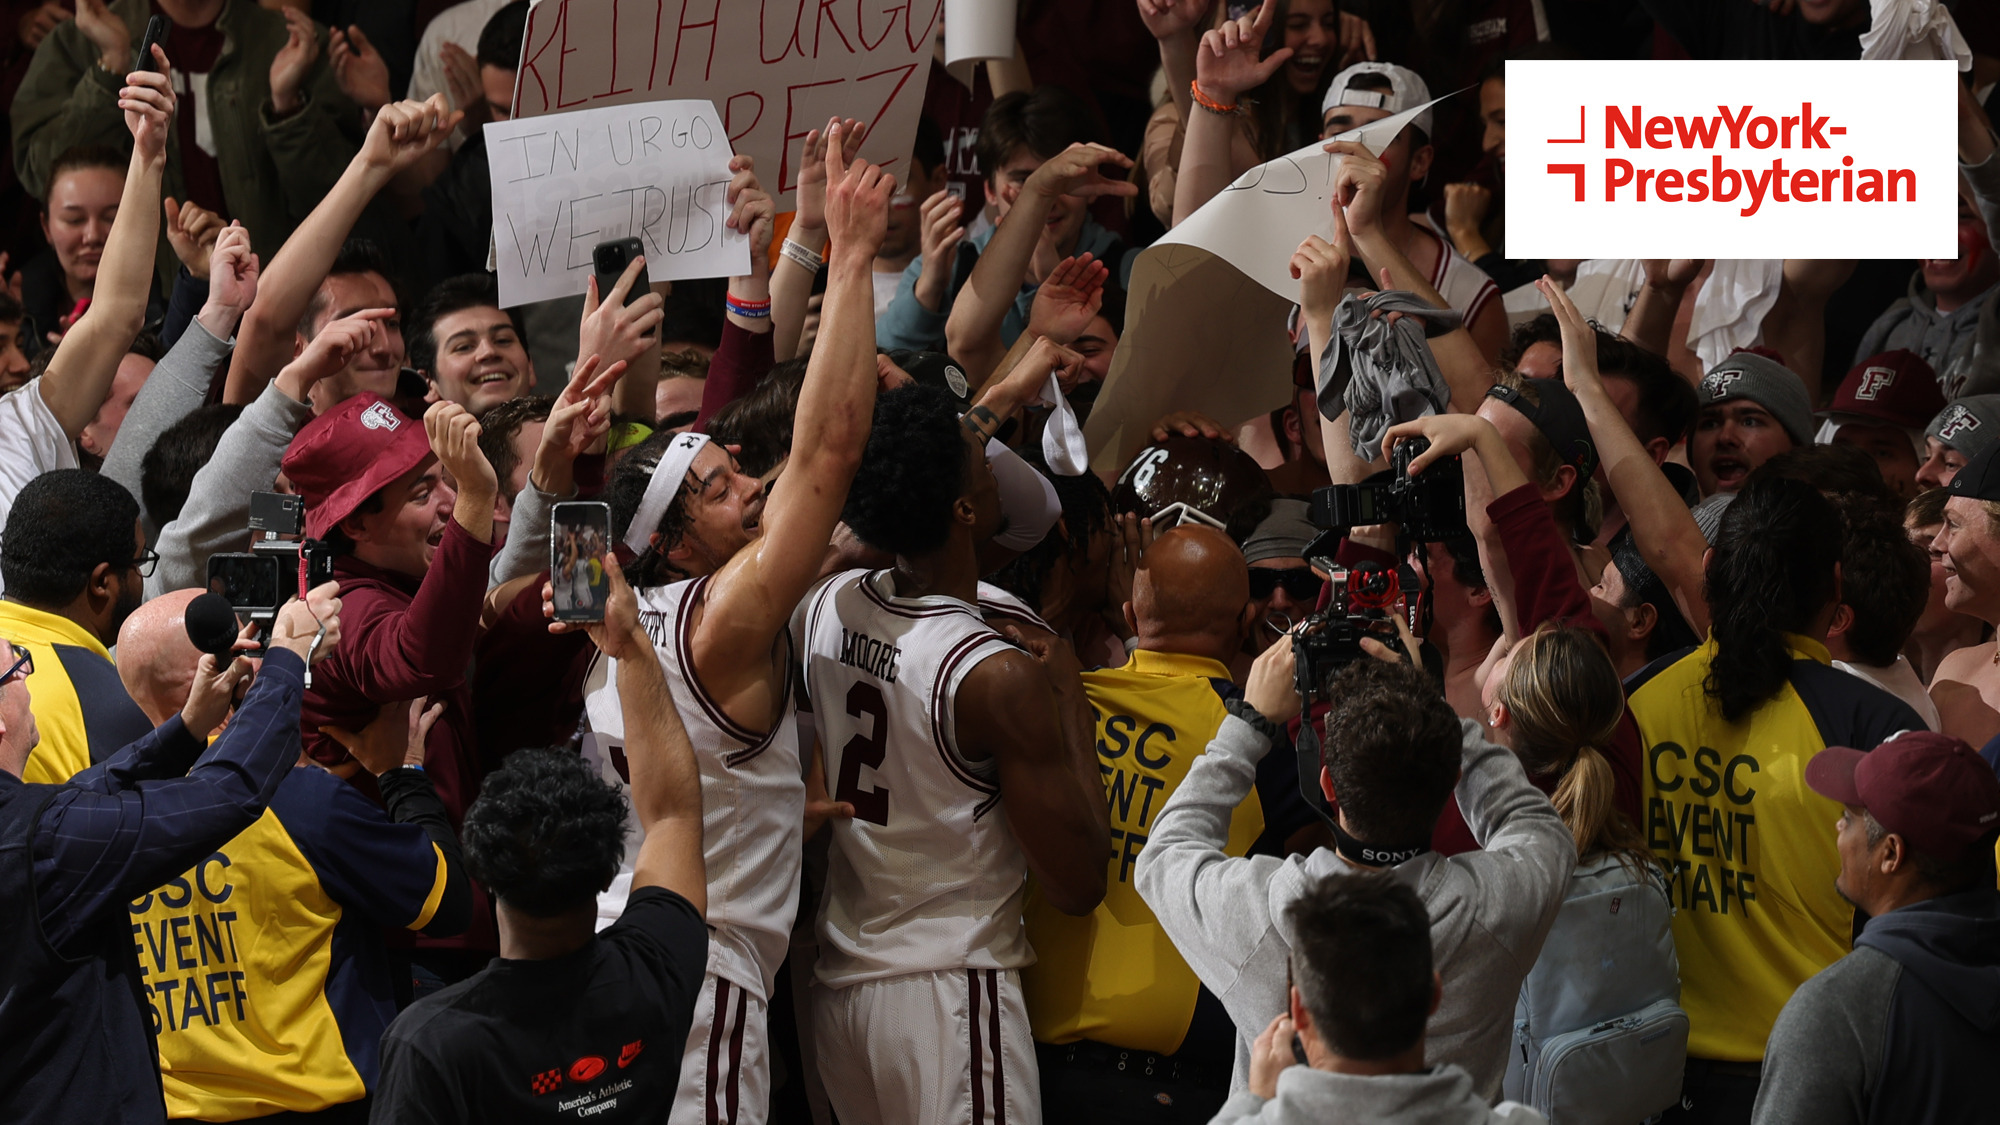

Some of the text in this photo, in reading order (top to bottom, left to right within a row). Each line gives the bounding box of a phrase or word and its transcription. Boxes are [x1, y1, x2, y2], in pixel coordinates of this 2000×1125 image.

[500, 115, 713, 184] IN URGO
[506, 180, 733, 278] WE TRUST
[1855, 366, 1897, 401] F
[839, 627, 902, 684] MOORE
[834, 680, 890, 827] 2
[1092, 705, 1177, 770] SC
[1650, 741, 1760, 806] CSC
[1362, 848, 1420, 863] SONY
[1648, 797, 1756, 866] EVENT
[558, 1079, 633, 1112] America's Athletic
[577, 1097, 618, 1118] Company
